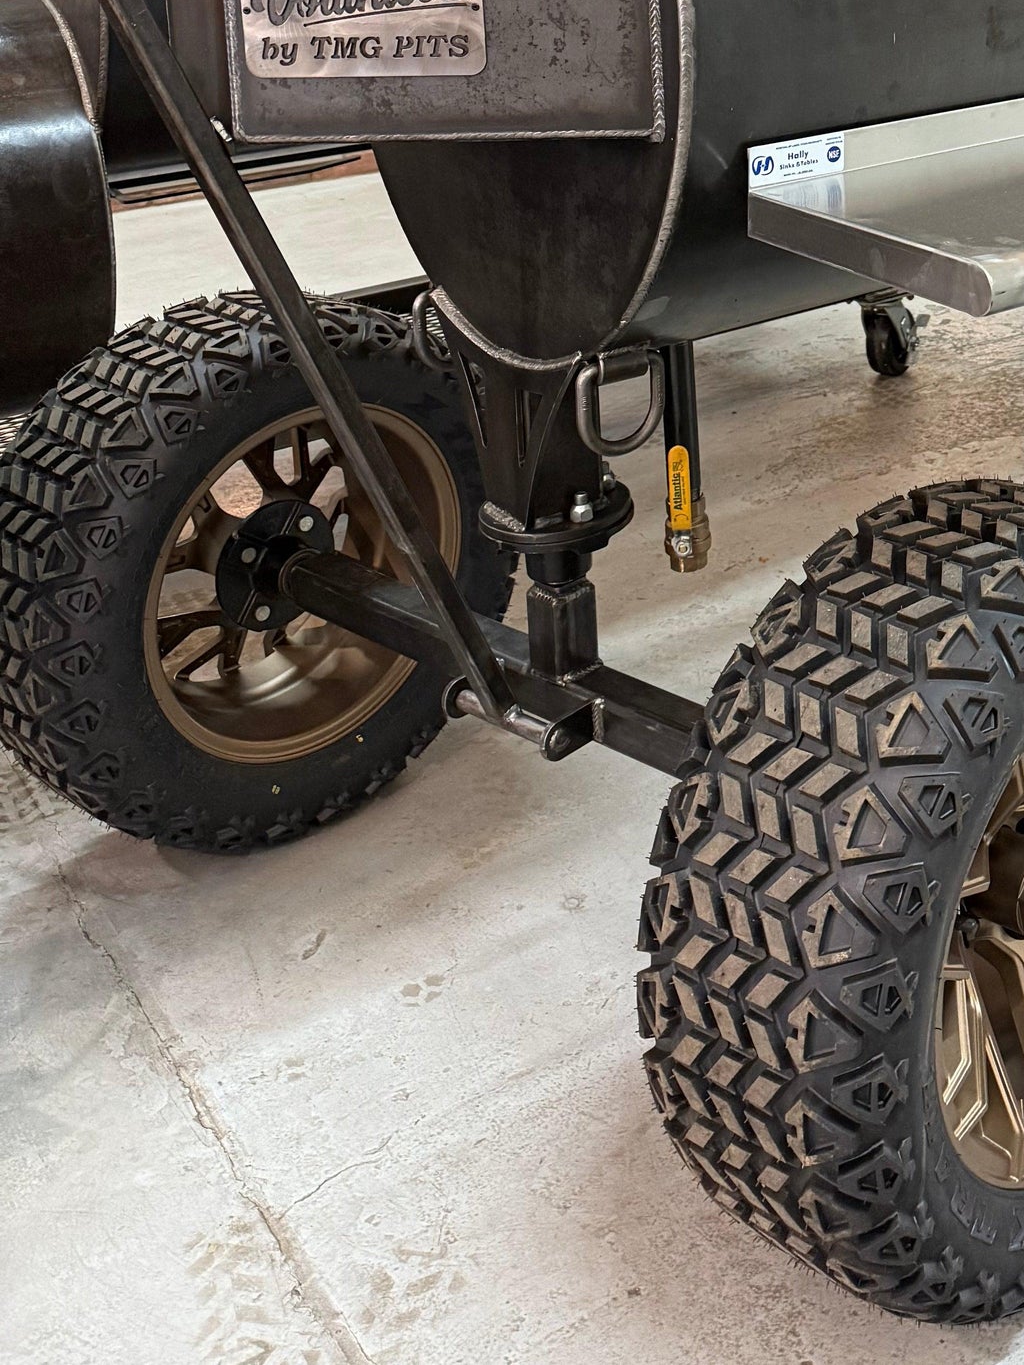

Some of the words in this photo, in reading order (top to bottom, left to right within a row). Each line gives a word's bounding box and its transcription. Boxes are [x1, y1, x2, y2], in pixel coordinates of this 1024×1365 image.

[262, 37, 298, 66] by
[310, 36, 383, 59] TMG
[392, 35, 470, 59] PITS
[672, 472, 683, 511] Atlantic
